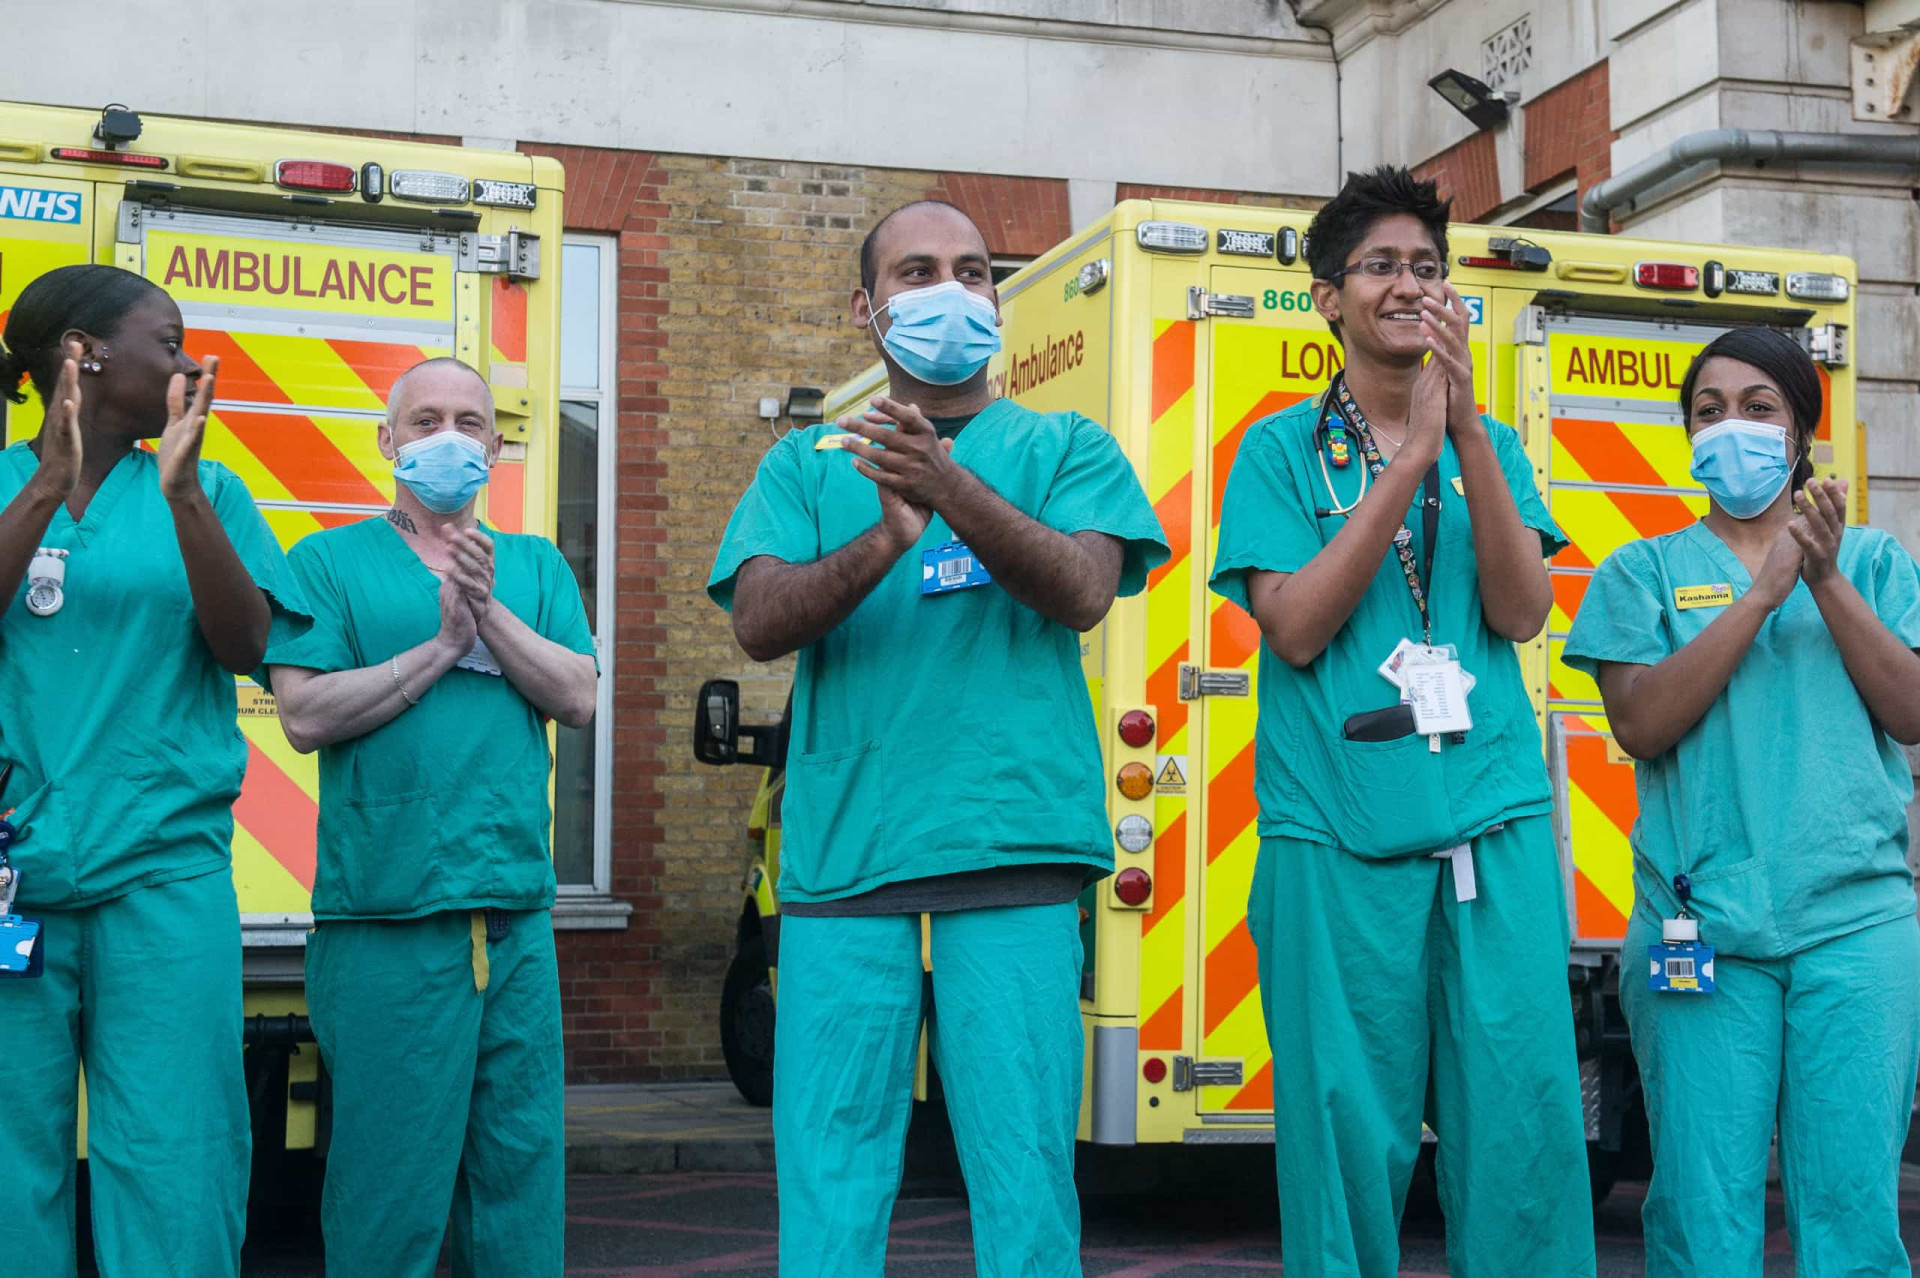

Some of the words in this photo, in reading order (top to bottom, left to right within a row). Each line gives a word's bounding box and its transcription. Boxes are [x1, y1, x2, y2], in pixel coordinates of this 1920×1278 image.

[0, 188, 79, 221] NHS
[164, 245, 434, 306] AMBULANCE
[1262, 289, 1316, 312] 860
[1009, 329, 1084, 400] Ambulance
[1566, 346, 1697, 389] AMBUL
[1679, 592, 1729, 602] Kashanna
